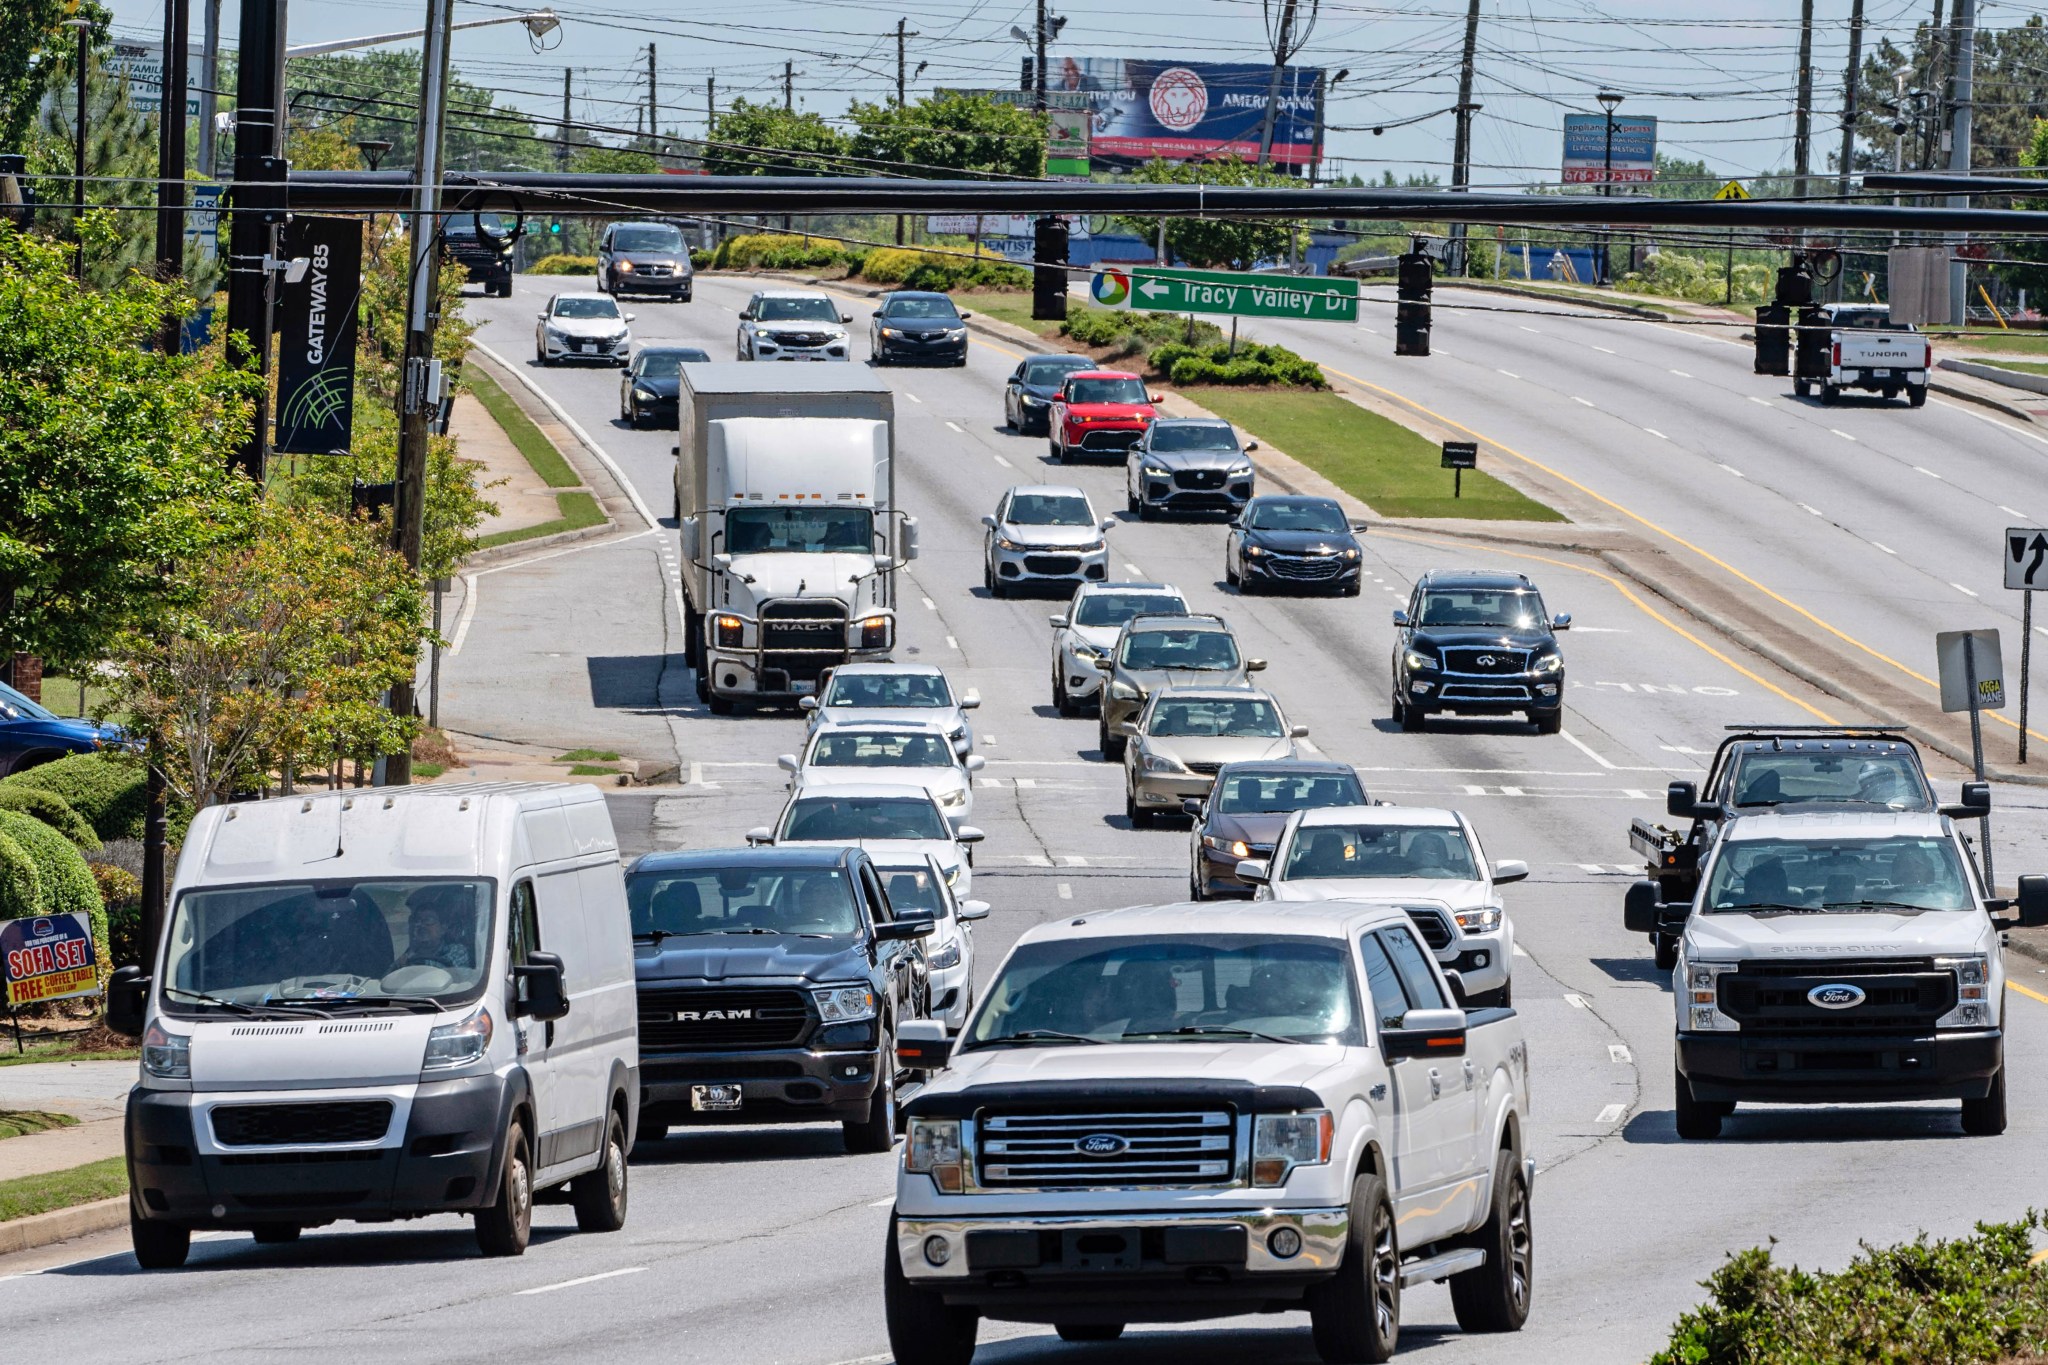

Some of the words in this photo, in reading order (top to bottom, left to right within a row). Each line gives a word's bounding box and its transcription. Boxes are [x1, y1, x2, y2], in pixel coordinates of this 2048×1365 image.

[1112, 91, 1136, 101] YOU
[1222, 94, 1270, 109] AMERI
[1276, 96, 1315, 111] BANK
[1183, 282, 1239, 310] Tracy
[1252, 283, 1314, 315] Valley
[1326, 289, 1348, 311] Dr
[771, 622, 833, 632] MACK
[1979, 679, 2001, 694] VEGA
[1980, 691, 2003, 704] MANE
[9, 945, 55, 978] SOFA
[55, 938, 86, 969] SET
[44, 972, 71, 987] COFFEE
[72, 967, 94, 982] TABLE
[13, 978, 44, 1002] FREE
[1823, 990, 1850, 1002] Ford
[677, 1009, 751, 1021] RAM
[1085, 1137, 1116, 1151] Ford
